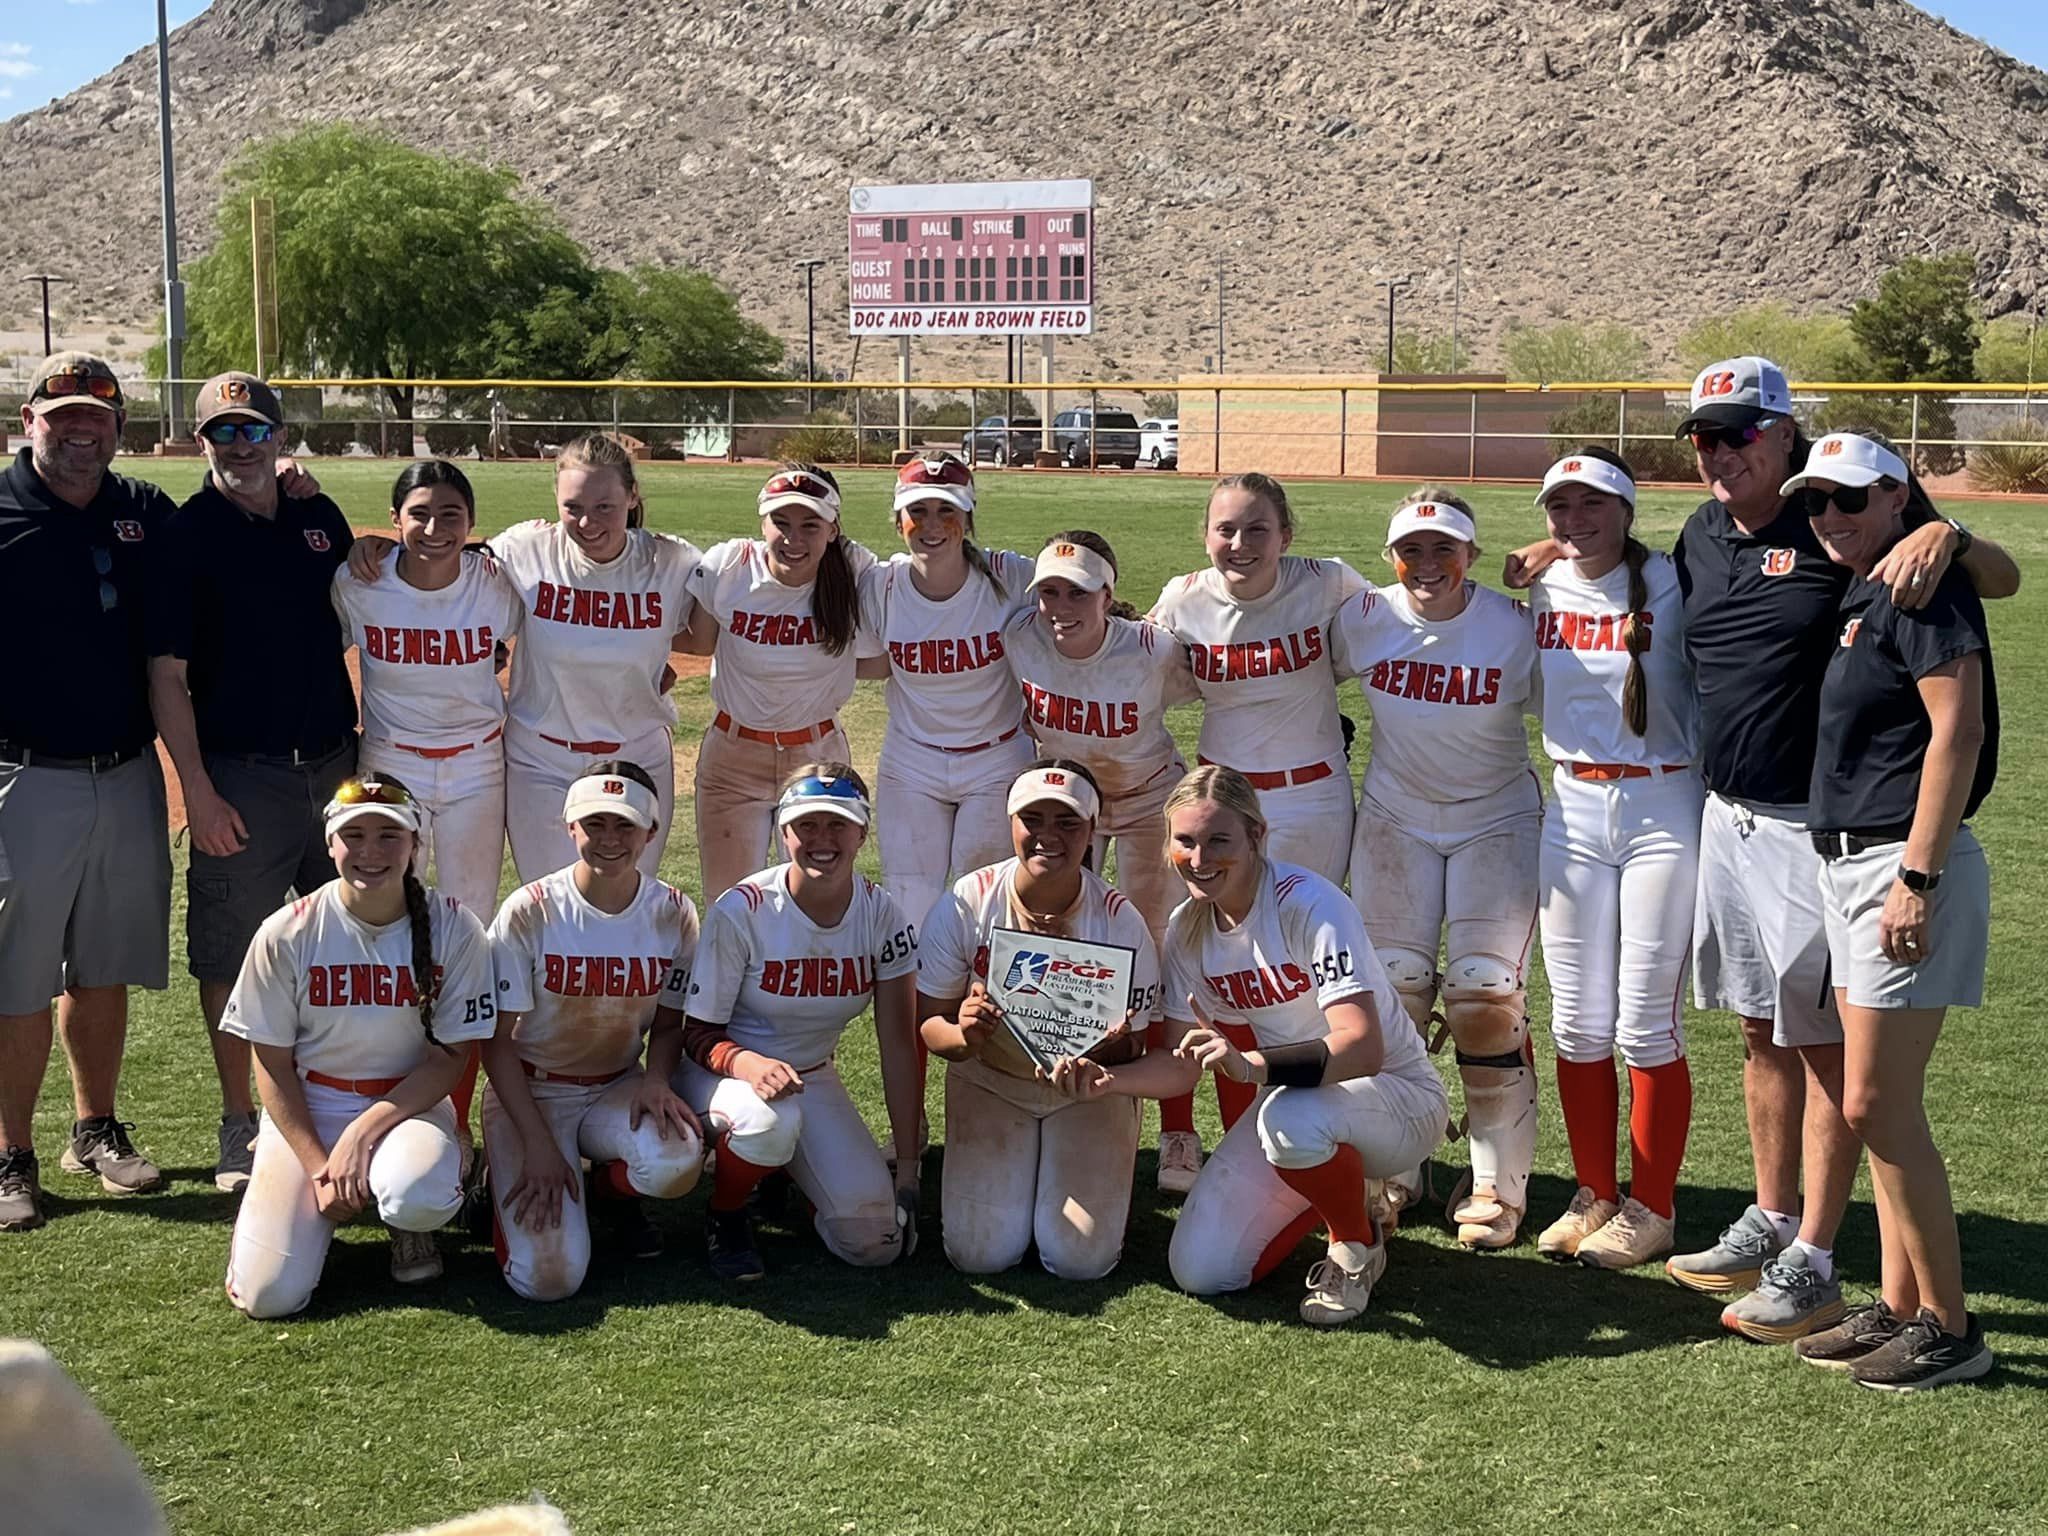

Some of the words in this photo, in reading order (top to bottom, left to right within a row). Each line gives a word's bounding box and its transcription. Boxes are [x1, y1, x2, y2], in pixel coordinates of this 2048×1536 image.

[855, 223, 880, 238] TIME
[921, 221, 950, 236] BALL
[972, 219, 1013, 234] STRIKE
[1047, 218, 1072, 233] OUT
[906, 247, 912, 258] 1
[921, 246, 928, 258] 2
[936, 246, 943, 257] 3
[957, 245, 963, 256] 4
[972, 245, 978, 256] 5
[987, 245, 993, 256] 6
[1008, 244, 1015, 256] 7
[1024, 244, 1030, 256] 8
[1039, 244, 1046, 256] 9
[1058, 243, 1086, 255] RUNS
[852, 261, 892, 278] GUEST
[853, 283, 892, 299] HOME
[854, 311, 885, 328] DOC
[889, 311, 922, 328] AND
[927, 311, 969, 328] JEAN
[975, 310, 1035, 329] BROWN
[1040, 310, 1087, 328] FIELD
[533, 580, 662, 630] BENGALS
[364, 625, 492, 666] BENGALS
[889, 631, 1004, 674] BENGALS
[1190, 625, 1324, 683] BENGALS
[1369, 658, 1502, 706] BENGALS
[880, 923, 918, 964] BSC
[309, 964, 445, 1007] BENGAS
[759, 954, 876, 997] BENGAL
[1049, 960, 1117, 980] PGF
[1205, 962, 1312, 1010] ENGALS
[1132, 979, 1159, 1012] BS
[1004, 1004, 1066, 1024] NATIONAL
[1068, 1014, 1108, 1030] BERTH
[1031, 1021, 1079, 1039] WINNER
